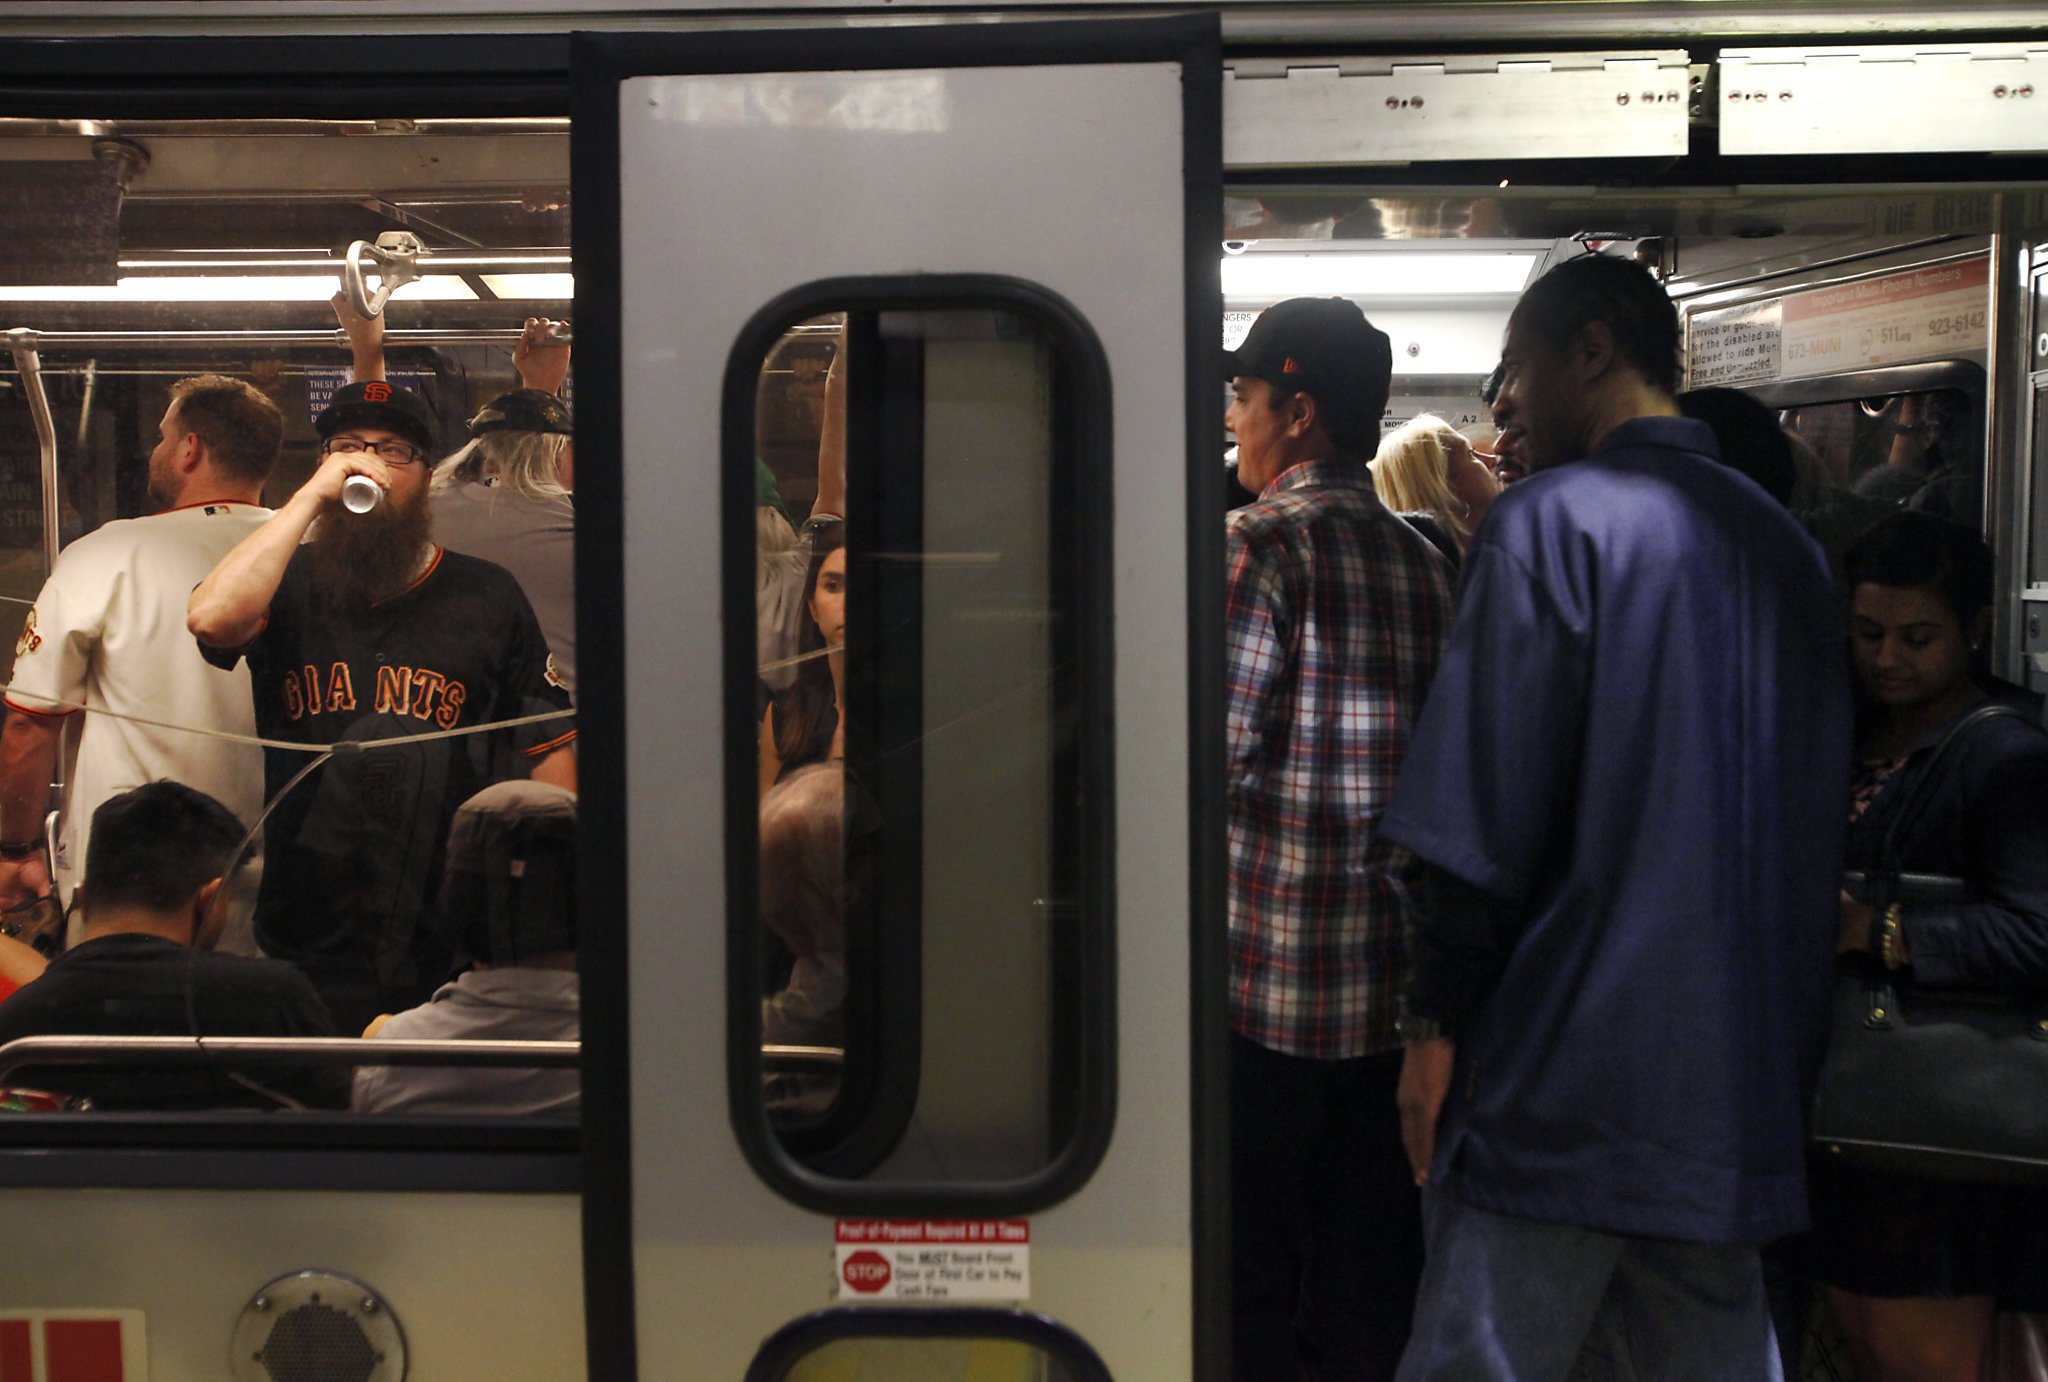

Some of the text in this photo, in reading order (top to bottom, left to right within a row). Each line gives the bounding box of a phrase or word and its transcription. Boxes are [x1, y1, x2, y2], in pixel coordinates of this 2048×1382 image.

[1811, 268, 1962, 307] Important Muni Phone Numbers
[1691, 326, 1720, 339] service
[1722, 324, 1731, 333] or
[1928, 311, 1985, 337] 923-6142
[1706, 339, 1721, 349] the
[1724, 331, 1762, 346] disabled
[1788, 336, 1842, 360] 673-MUNI
[1691, 343, 1780, 366] allowed to ride Muni
[1691, 369, 1708, 378] Free
[1710, 366, 1725, 375] and
[310, 380, 335, 389] THESE
[363, 381, 393, 403] SF
[310, 391, 321, 400] BE
[919, 1252, 948, 1264] MUST
[951, 1252, 982, 1263] Board
[986, 1252, 1013, 1263] Front
[846, 1263, 888, 1281] STOP
[924, 1269, 936, 1280] of
[939, 1269, 962, 1280] First
[966, 1269, 985, 1280] Car
[1003, 1269, 1022, 1282] Pay
